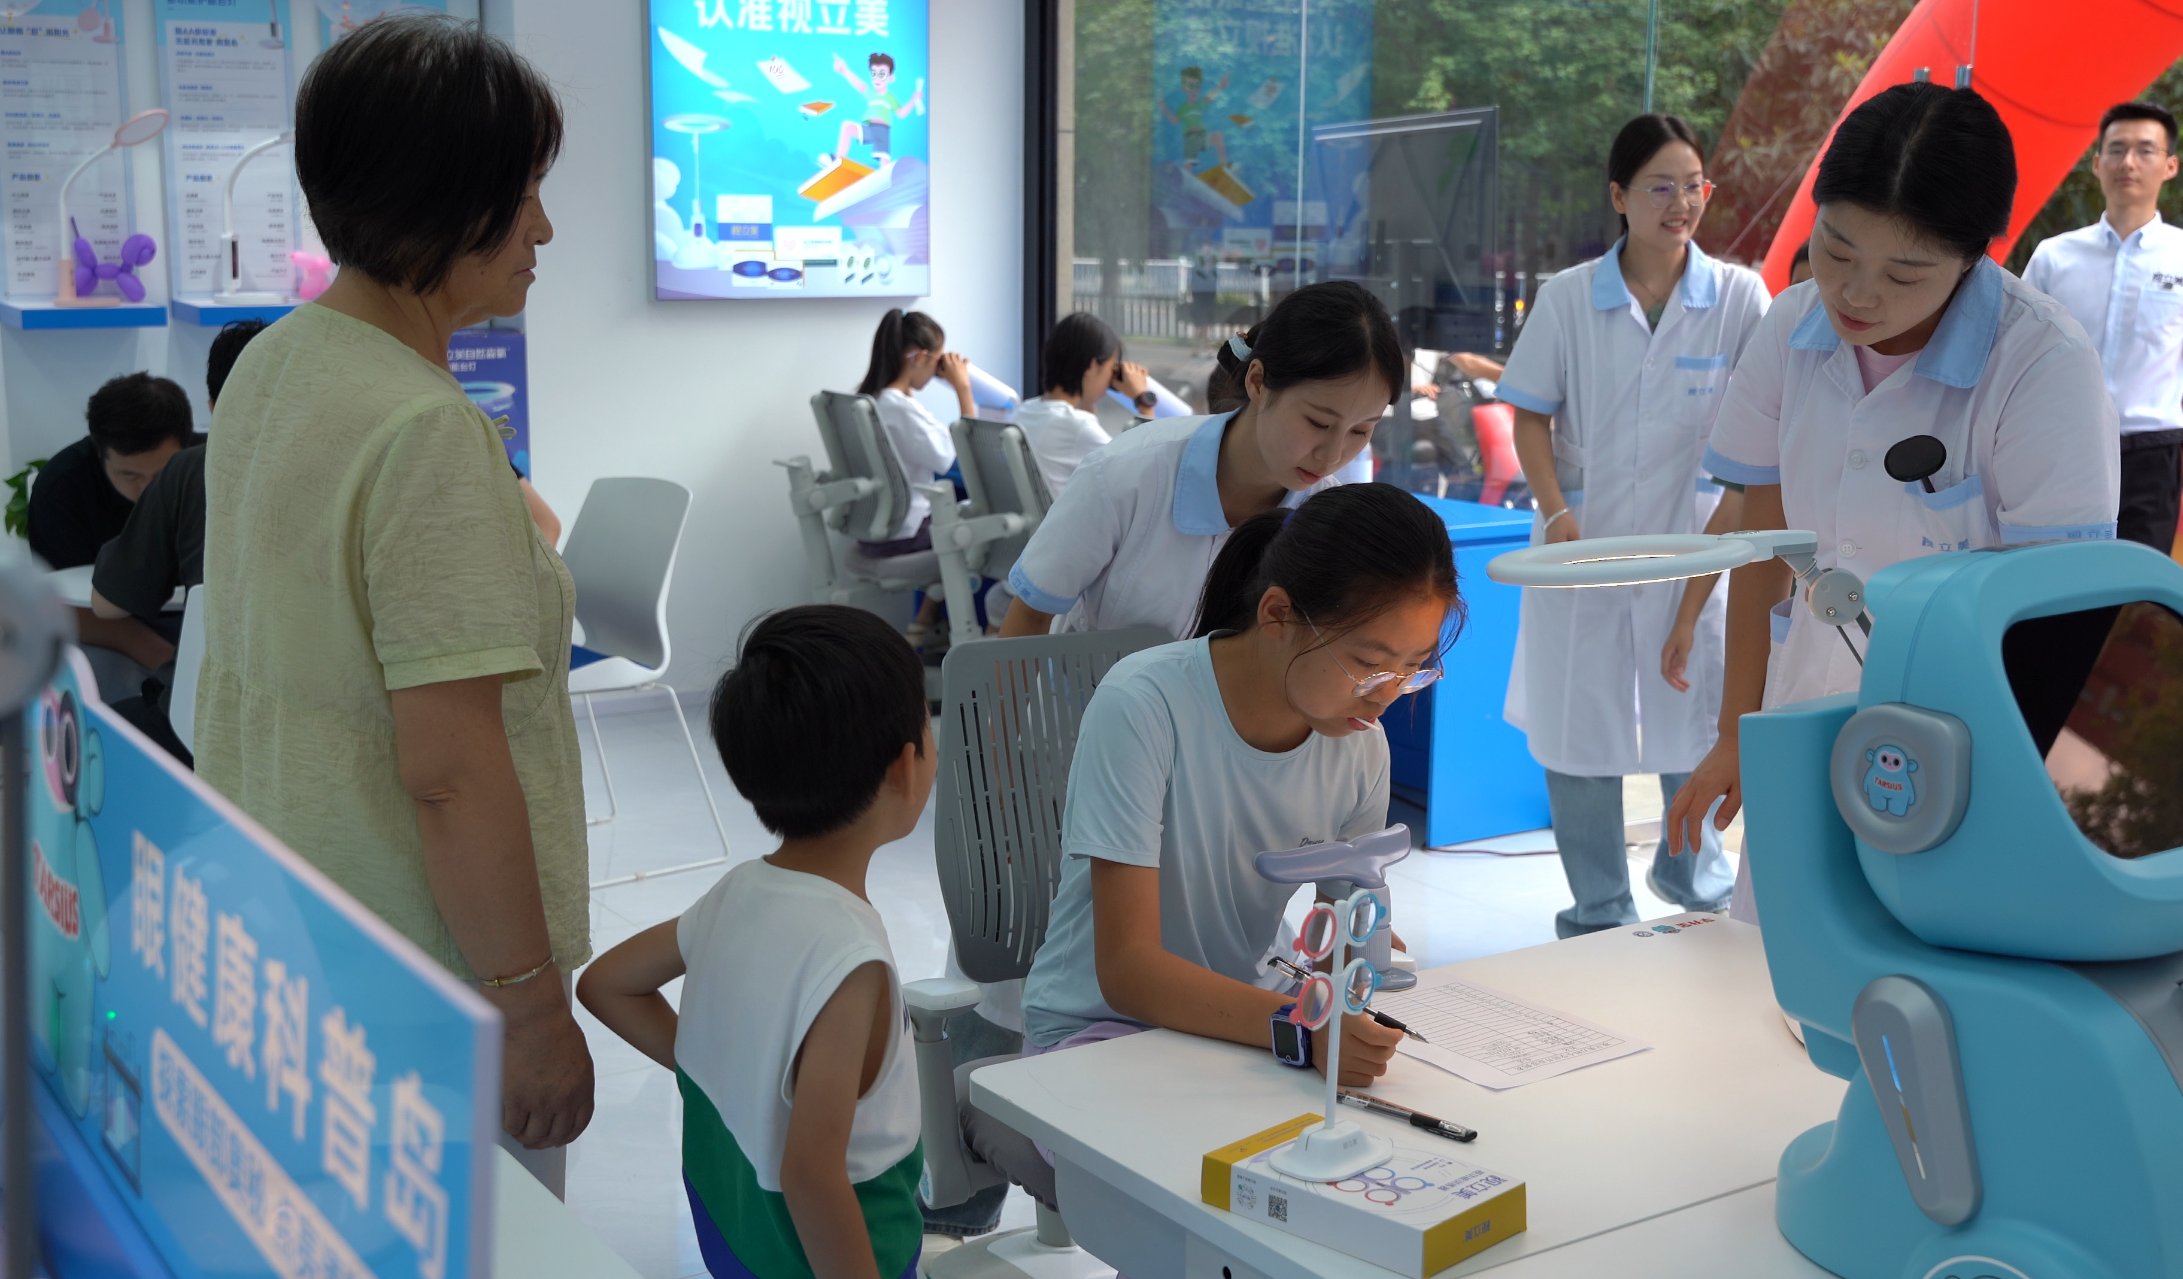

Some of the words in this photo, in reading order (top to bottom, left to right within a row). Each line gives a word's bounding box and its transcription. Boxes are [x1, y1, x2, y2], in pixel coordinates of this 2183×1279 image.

[694, 0, 890, 37] 认准视立美
[1875, 777, 1903, 791] TARSIUS
[131, 829, 448, 1279] 眼健康科普岛
[1451, 1174, 1508, 1200] 视立美
